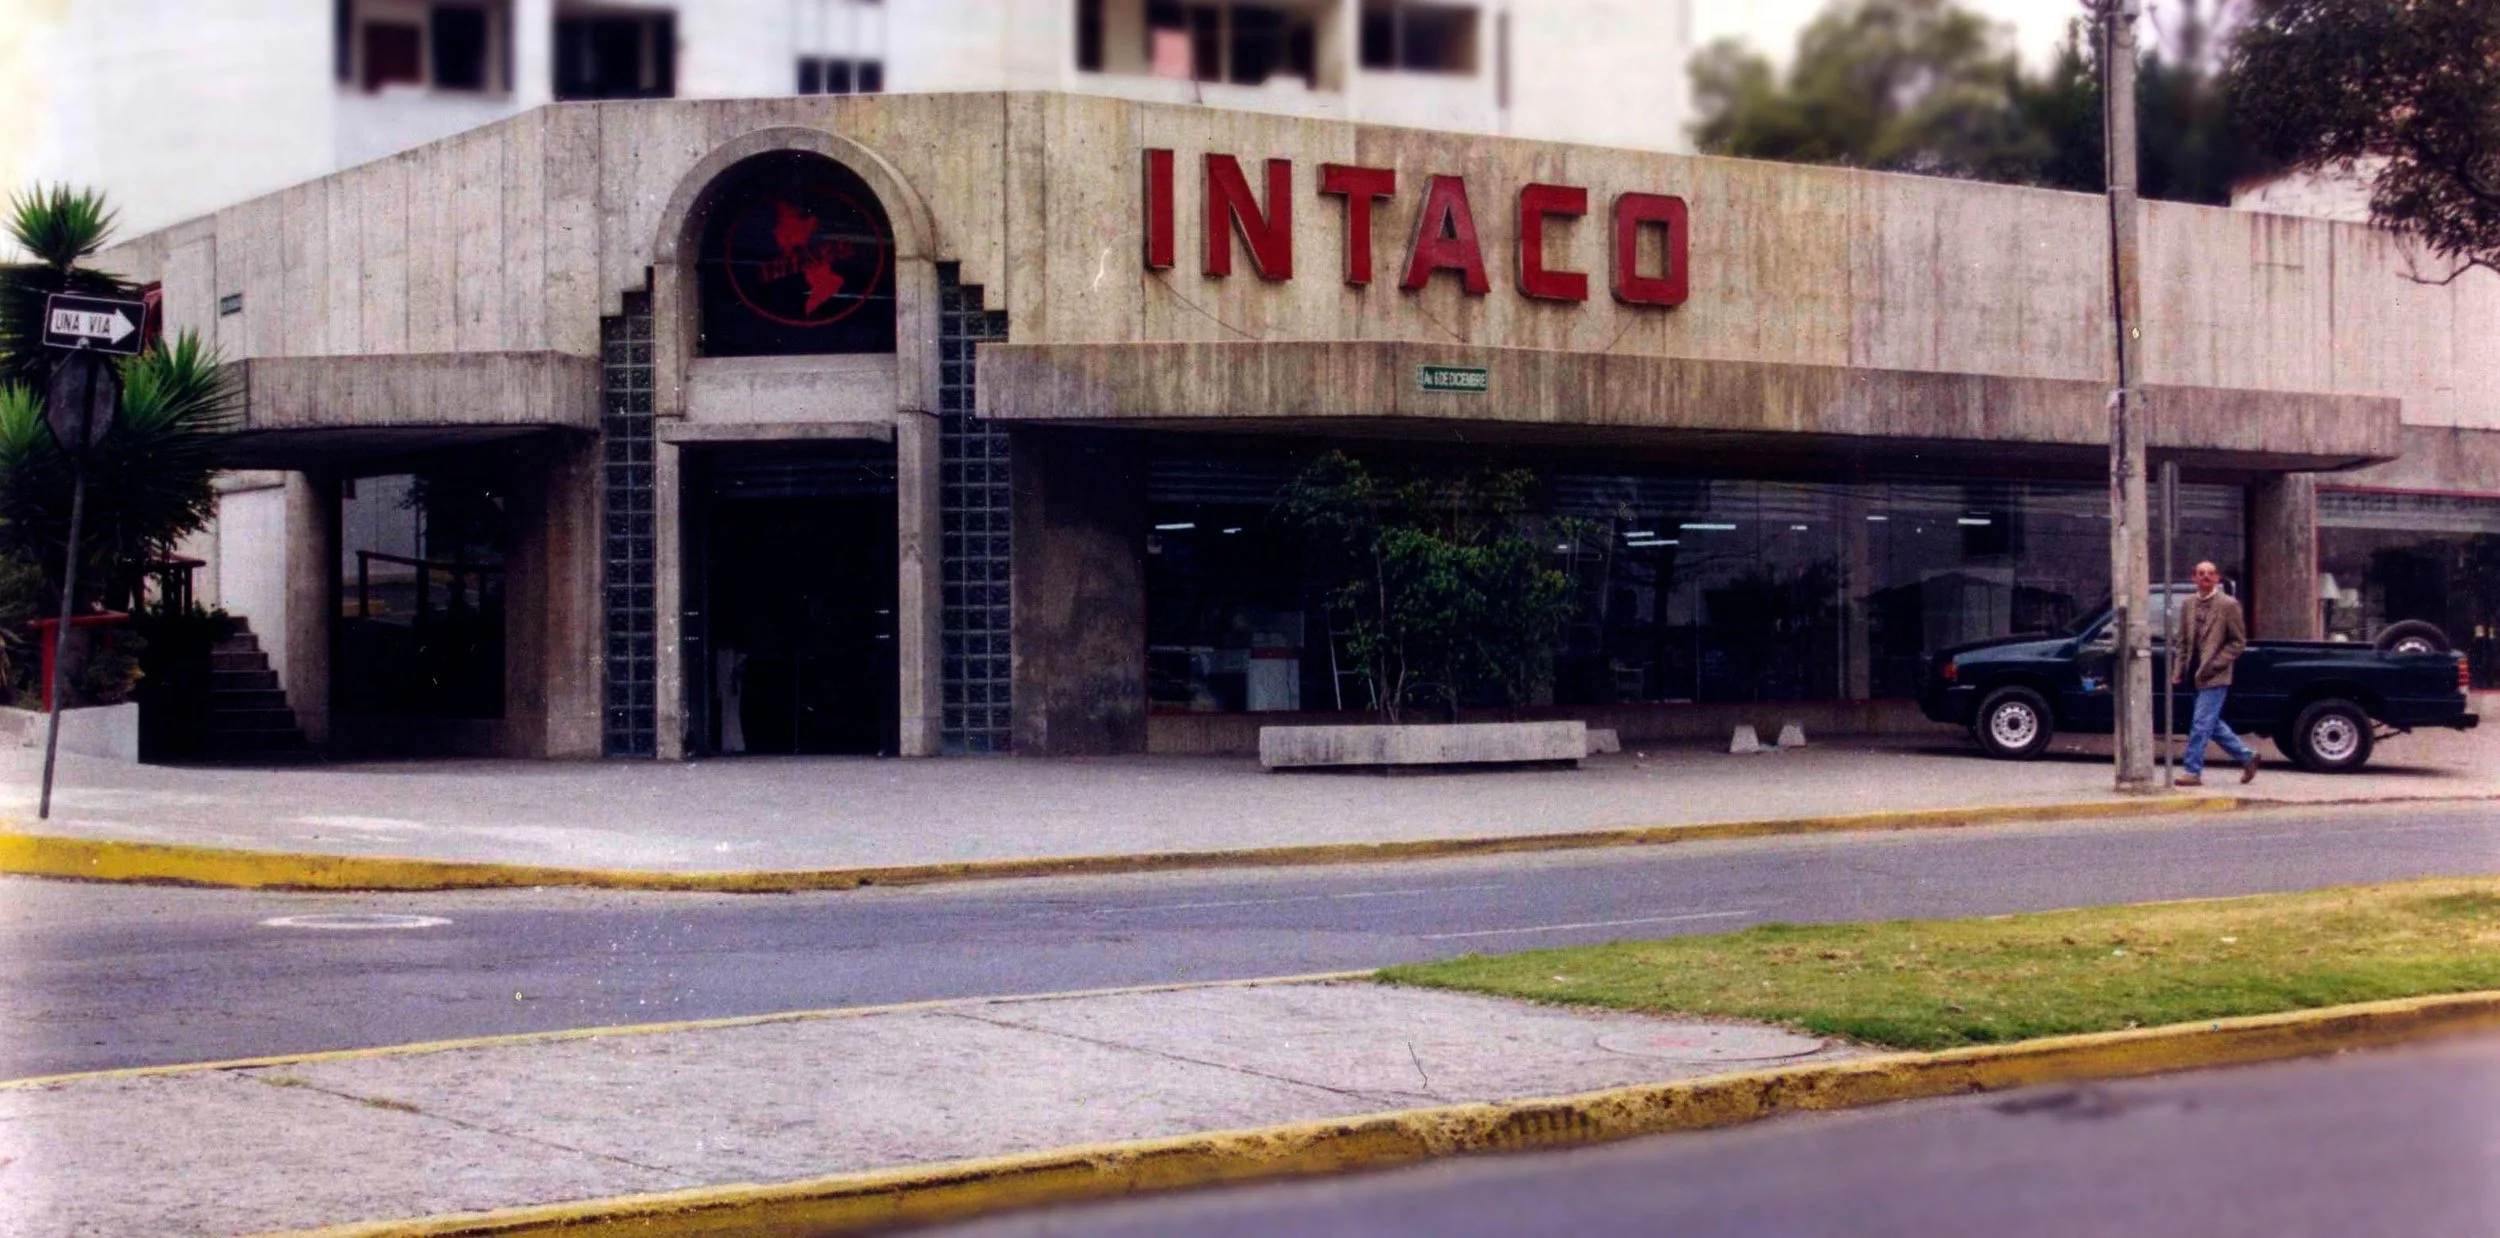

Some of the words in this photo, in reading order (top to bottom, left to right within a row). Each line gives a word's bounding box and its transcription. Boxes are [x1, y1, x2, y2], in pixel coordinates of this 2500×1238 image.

[1142, 148, 1689, 307] INTACO
[55, 313, 80, 331] UNA
[89, 316, 111, 334] VIA
